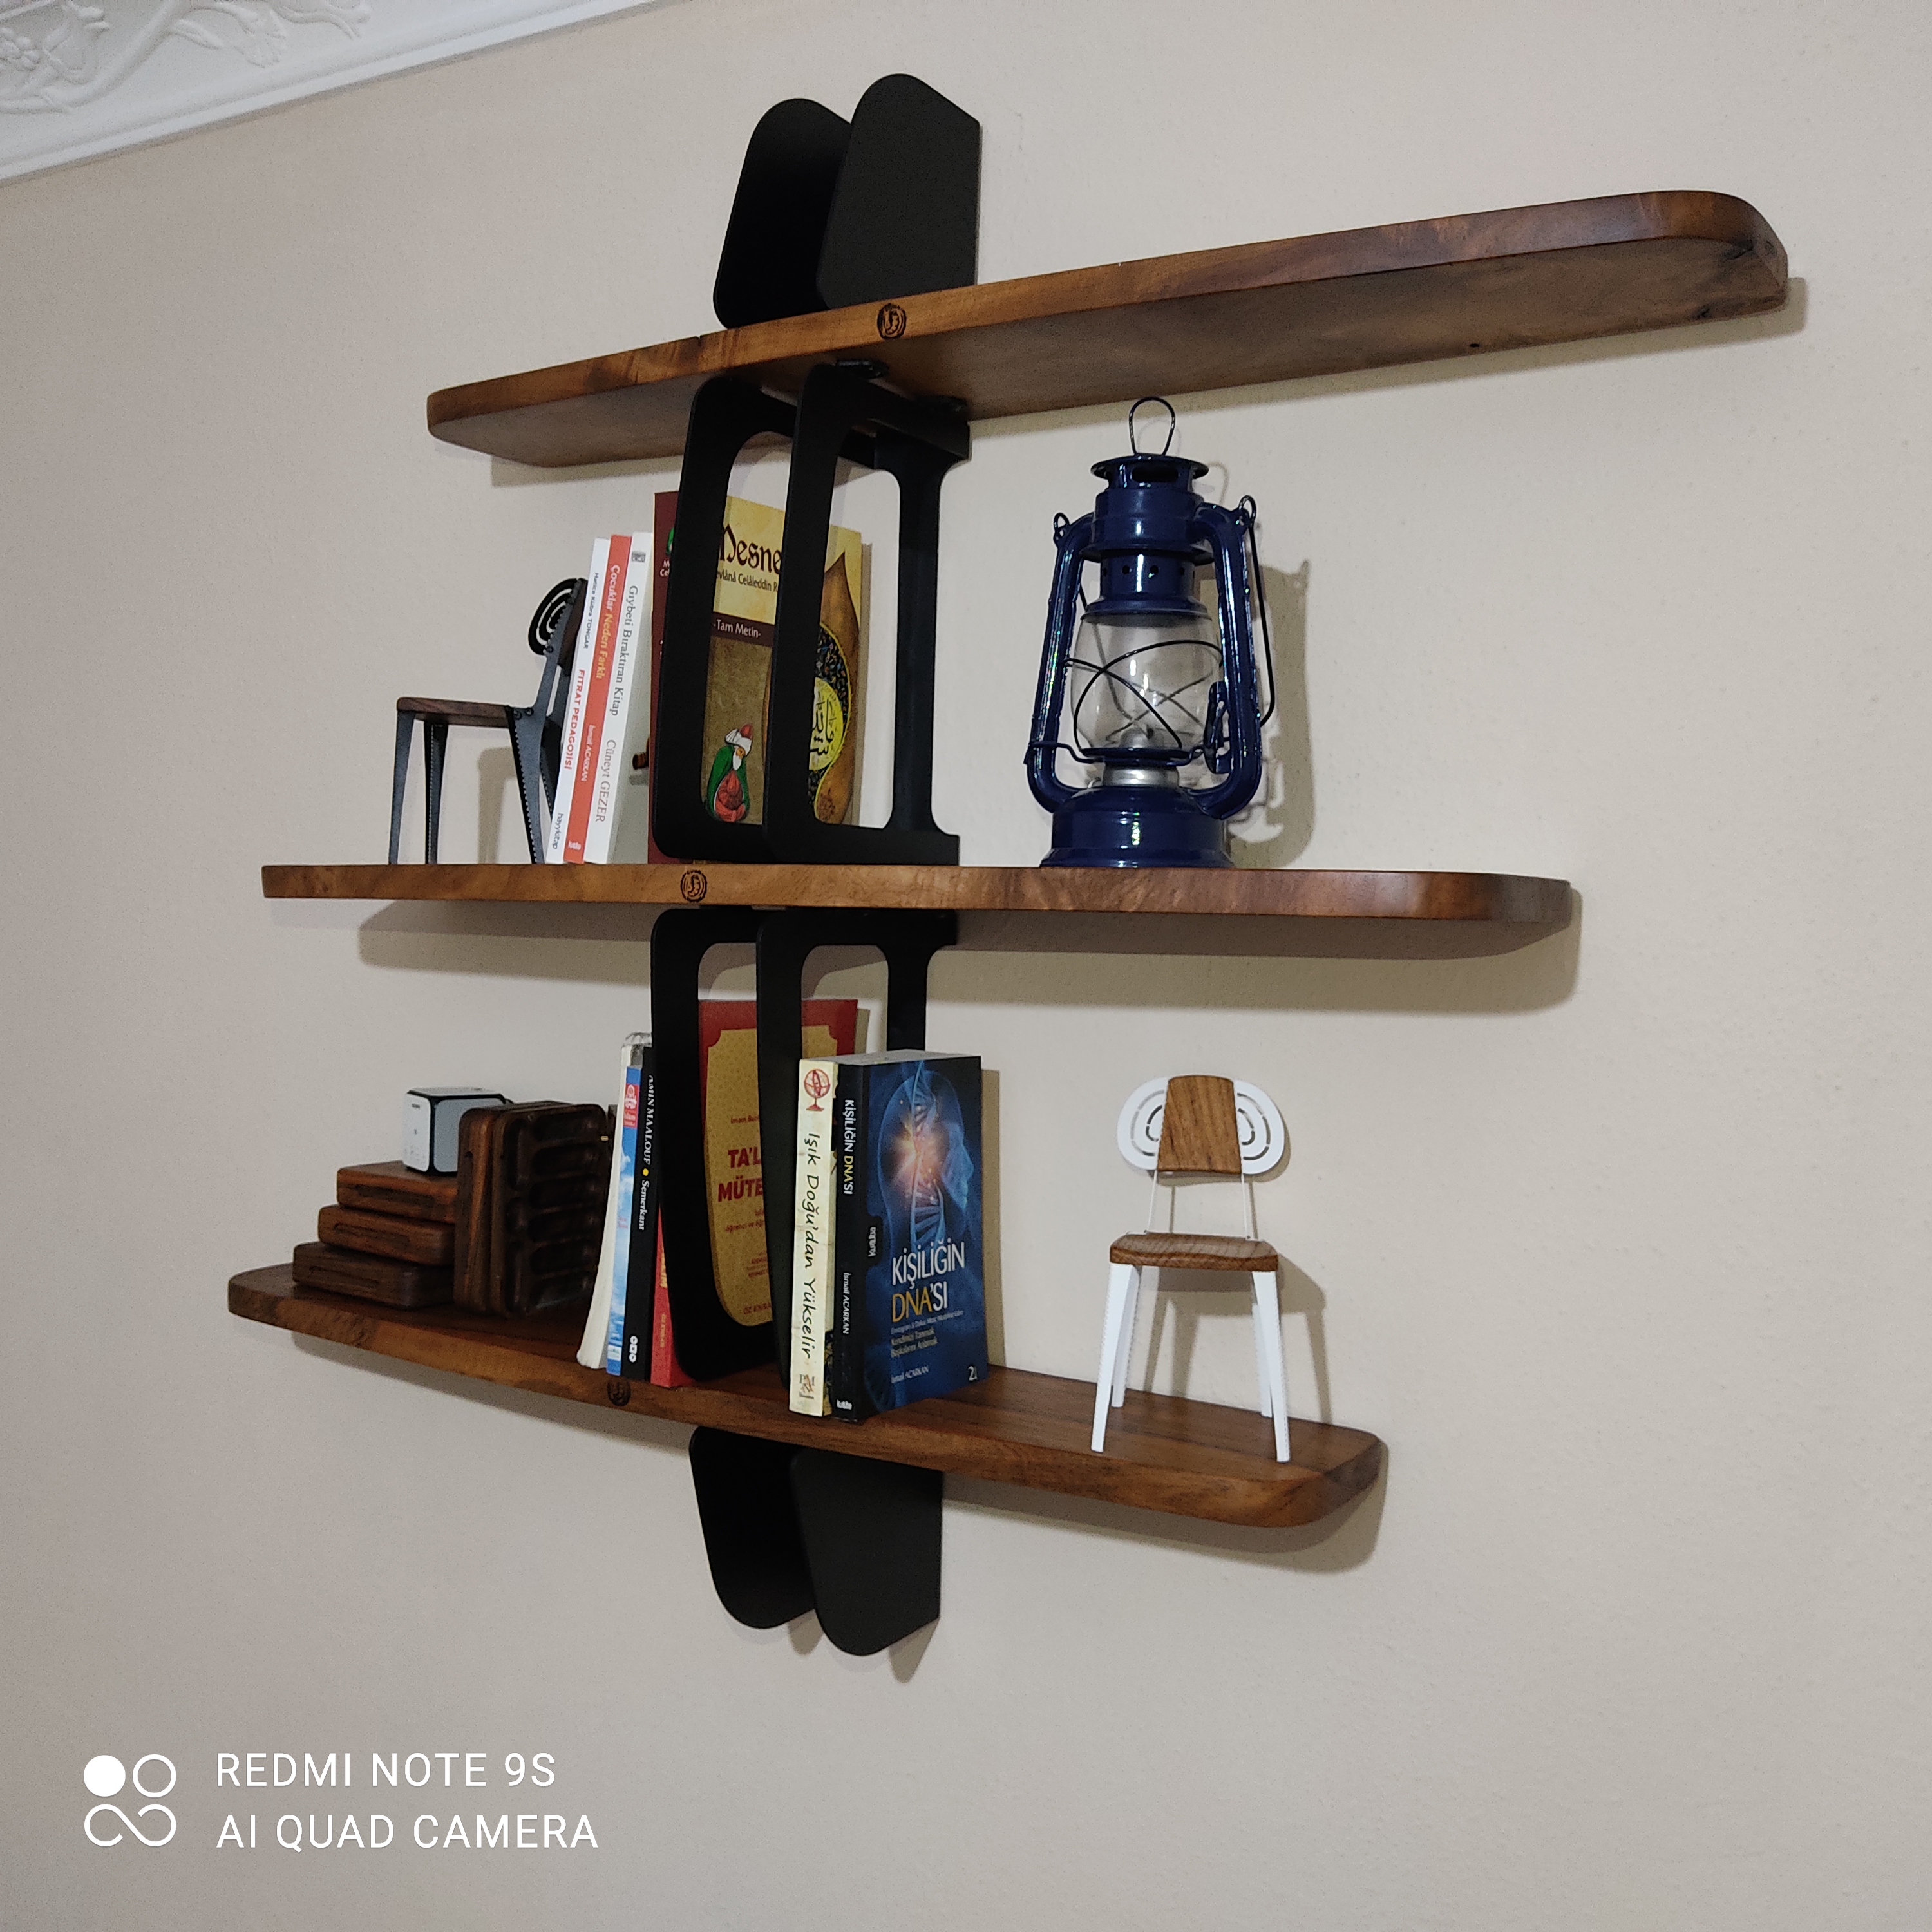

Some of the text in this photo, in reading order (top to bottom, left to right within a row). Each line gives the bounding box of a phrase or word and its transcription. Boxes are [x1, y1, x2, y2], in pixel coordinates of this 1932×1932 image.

[738, 573, 772, 591] Celâleddin
[583, 618, 592, 649] TONGAR
[596, 564, 620, 679] Çocuklar Neden Farklı
[609, 585, 638, 716] Gıybeti Bıraktıran Kitap
[565, 669, 585, 770] FITRAT PEDAGOJİSİ
[596, 739, 616, 822] Cüneyt GEZER
[643, 1107, 654, 1166] MAALOUF
[804, 1133, 820, 1166] Işık
[842, 1099, 856, 1195] KİŞİLİĞİN DNA'SI
[639, 1180, 650, 1231] Semerkant
[802, 1175, 820, 1269] Doğu'dan
[892, 1237, 965, 1289] KİŞİLİĞİN
[801, 1278, 817, 1359] Yükselir
[842, 1272, 851, 1334] İsmail ACARKAN
[892, 1281, 948, 1323] DNA'SI
